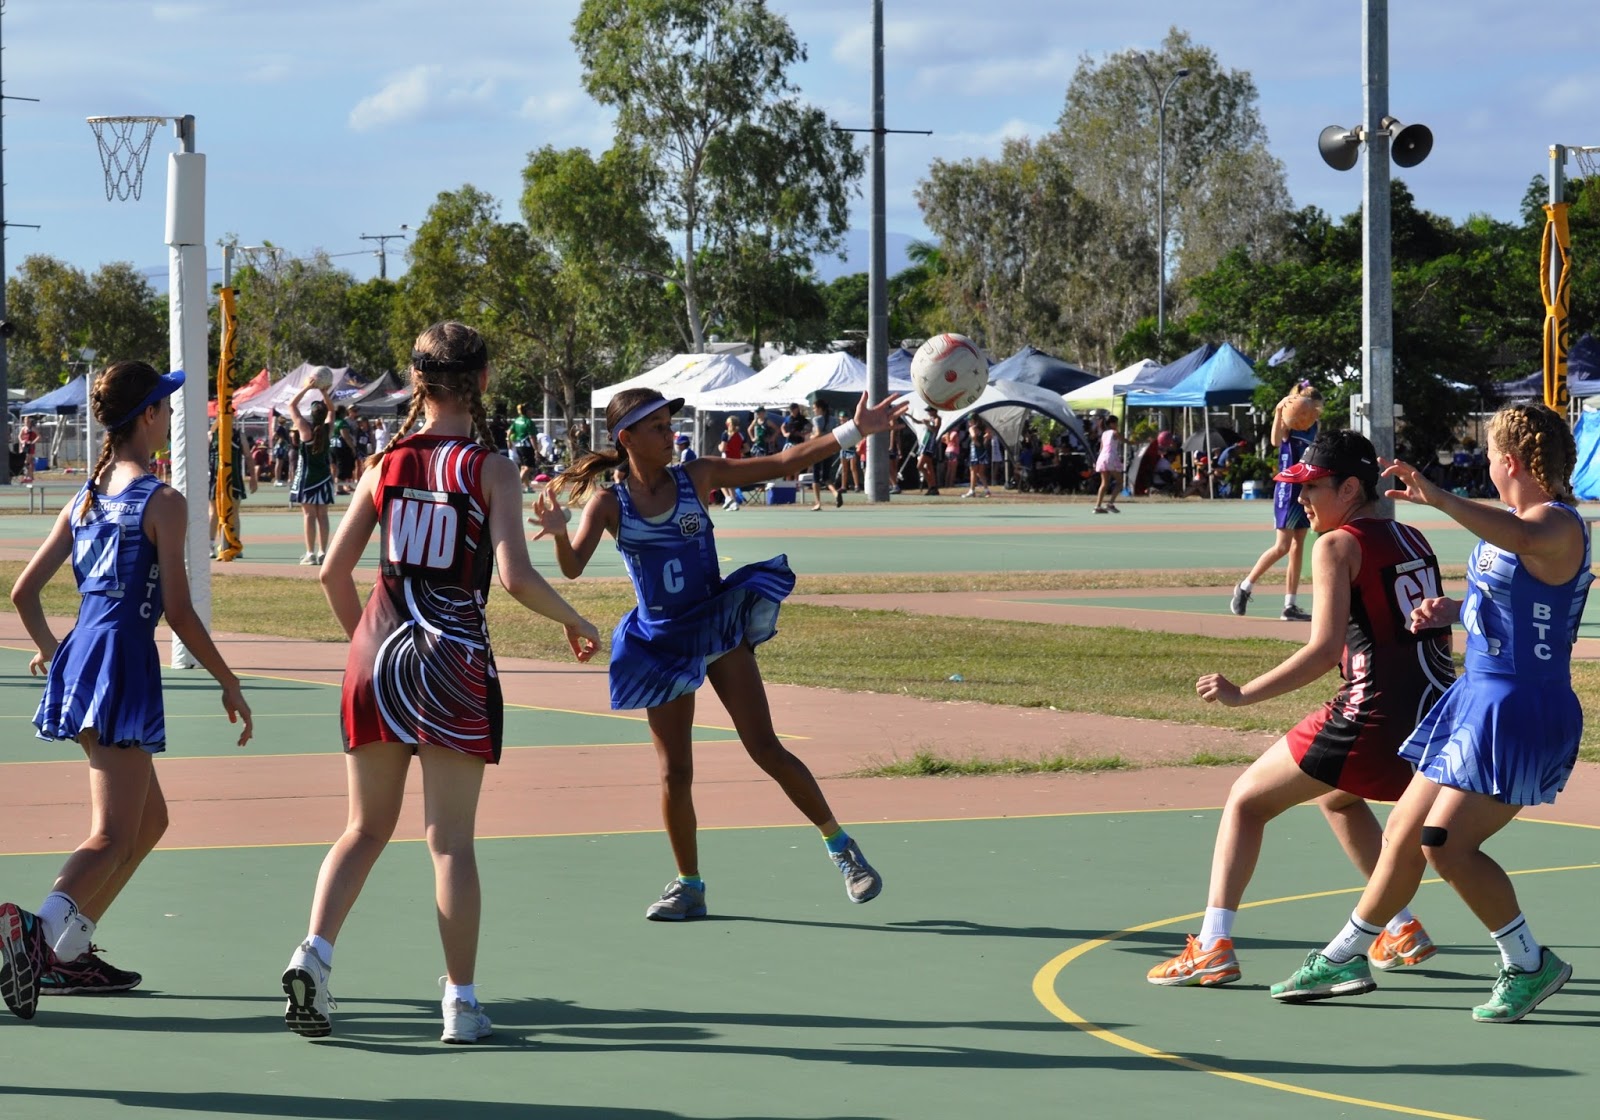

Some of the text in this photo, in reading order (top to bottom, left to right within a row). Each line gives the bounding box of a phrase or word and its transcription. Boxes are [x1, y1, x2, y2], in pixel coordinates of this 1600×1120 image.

[389, 498, 457, 569] WD
[140, 563, 160, 619] BTC
[663, 558, 684, 593] C
[1533, 602, 1552, 660] BTC
